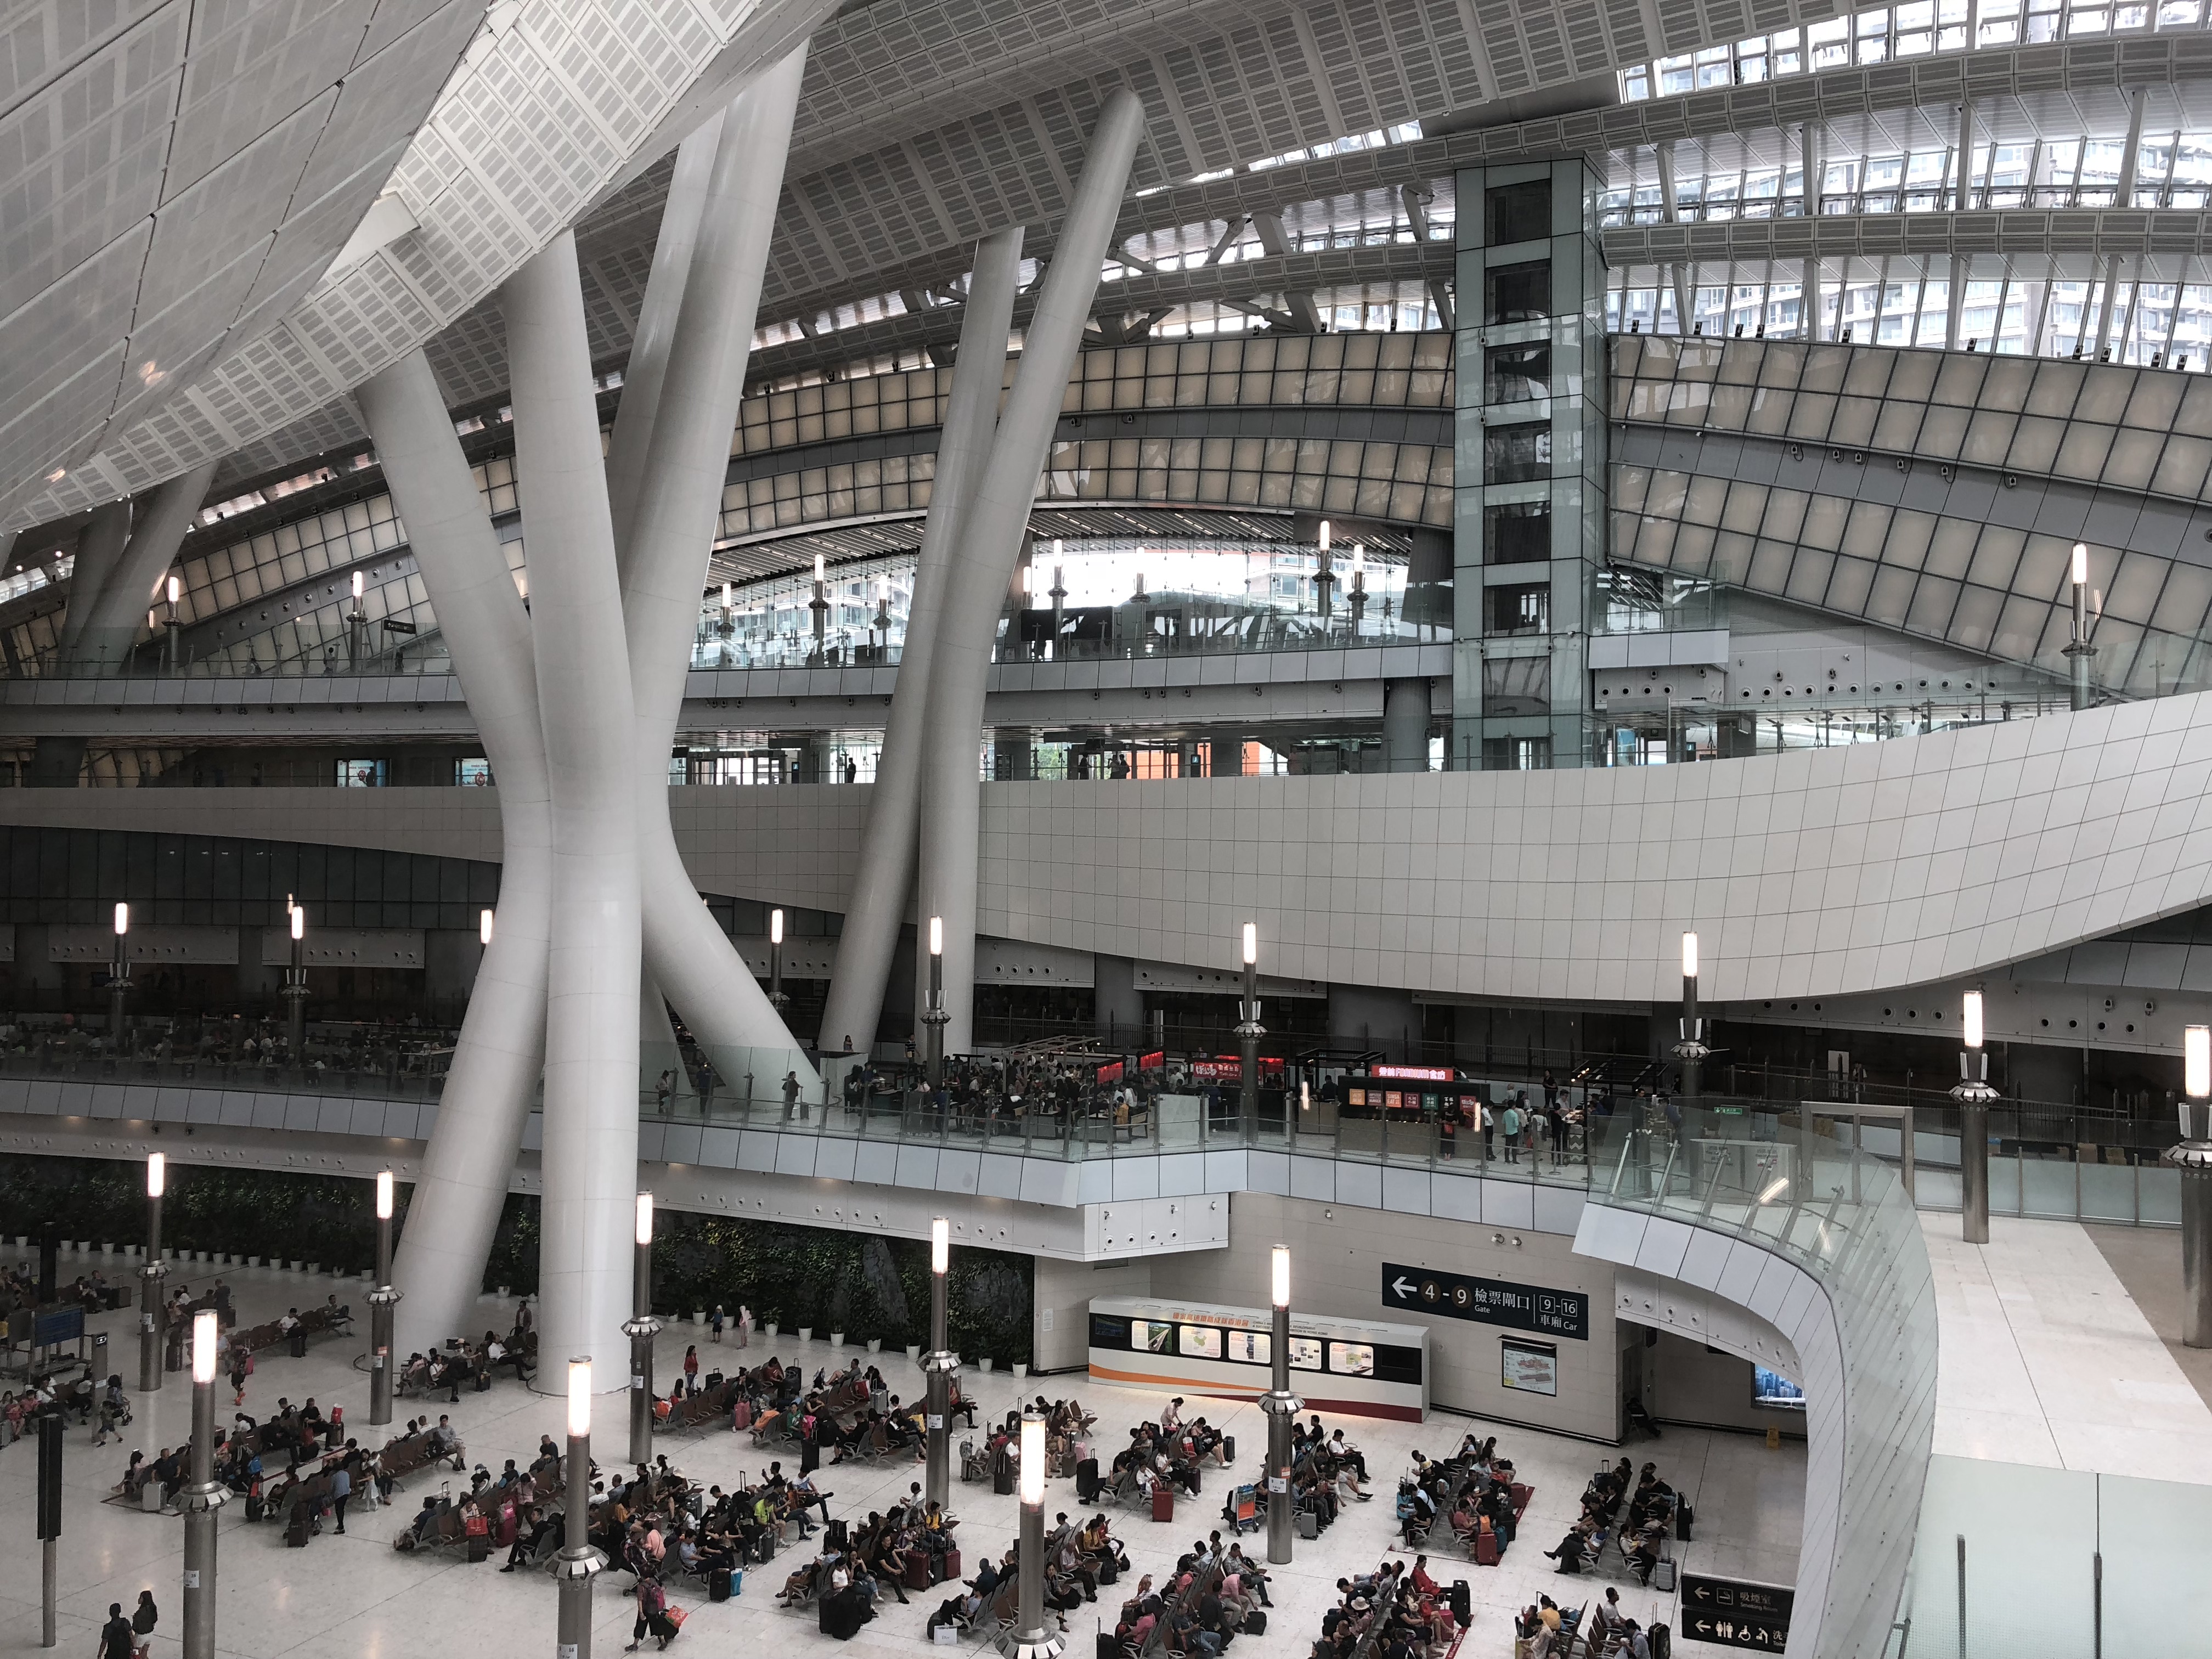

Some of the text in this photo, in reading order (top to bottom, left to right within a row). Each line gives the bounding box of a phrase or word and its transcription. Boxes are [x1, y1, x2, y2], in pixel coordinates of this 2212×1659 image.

[1474, 1288, 1530, 1310] 檢票閘口
[1475, 1305, 1491, 1314] Gate
[1539, 1314, 1578, 1331] 車廂 Car
